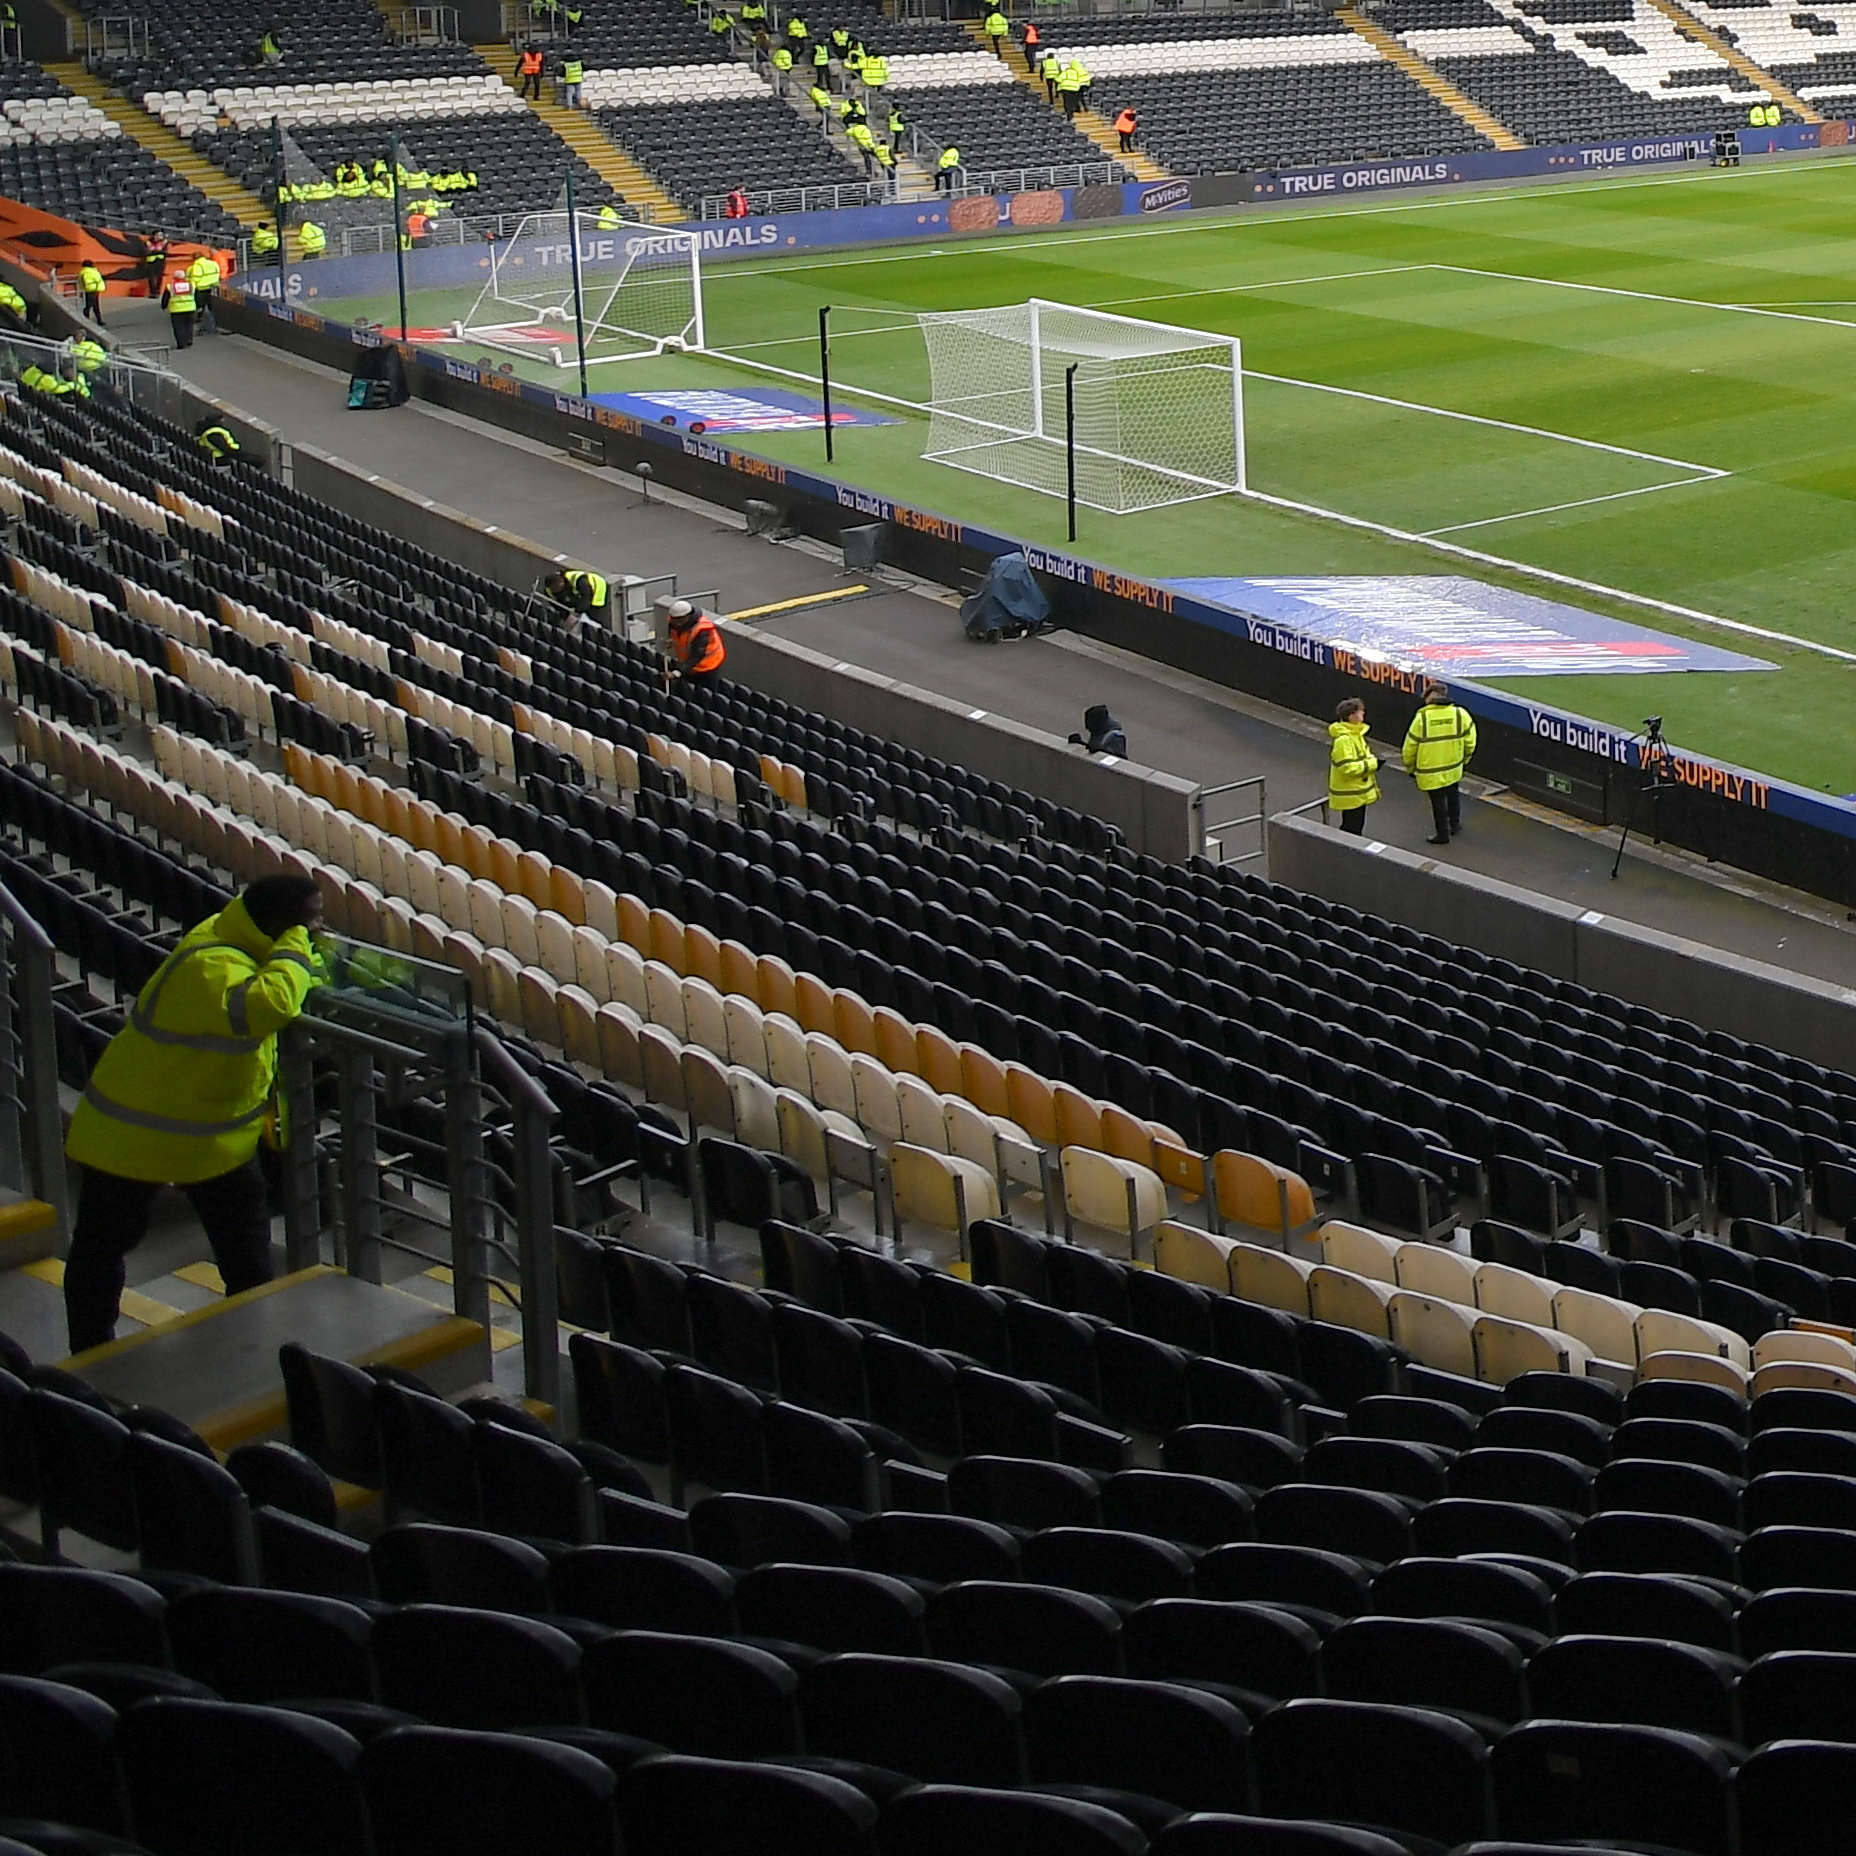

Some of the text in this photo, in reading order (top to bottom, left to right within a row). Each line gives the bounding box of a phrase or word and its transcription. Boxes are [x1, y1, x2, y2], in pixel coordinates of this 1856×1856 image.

[1580, 146, 1628, 165] TRUE
[1281, 162, 1447, 195] TRUE ORIGINALS
[535, 238, 615, 265] TRUE
[729, 452, 746, 470] WE
[746, 456, 778, 482] SUPPLY
[777, 467, 786, 484] IT
[836, 486, 963, 543] You build it WE SUPPLY IT
[1022, 545, 1175, 613] You build it WE SUPPLY IT
[1246, 617, 1272, 647] You
[1275, 624, 1311, 659] build
[1311, 637, 1325, 666] it
[1332, 646, 1357, 676] WE
[1360, 654, 1417, 696] SUPPLY
[1528, 708, 1561, 742] You
[1564, 719, 1611, 758] build
[1612, 732, 1628, 765] it
[1674, 756, 1746, 801] SUPPLY
[1751, 780, 1770, 811] IT
